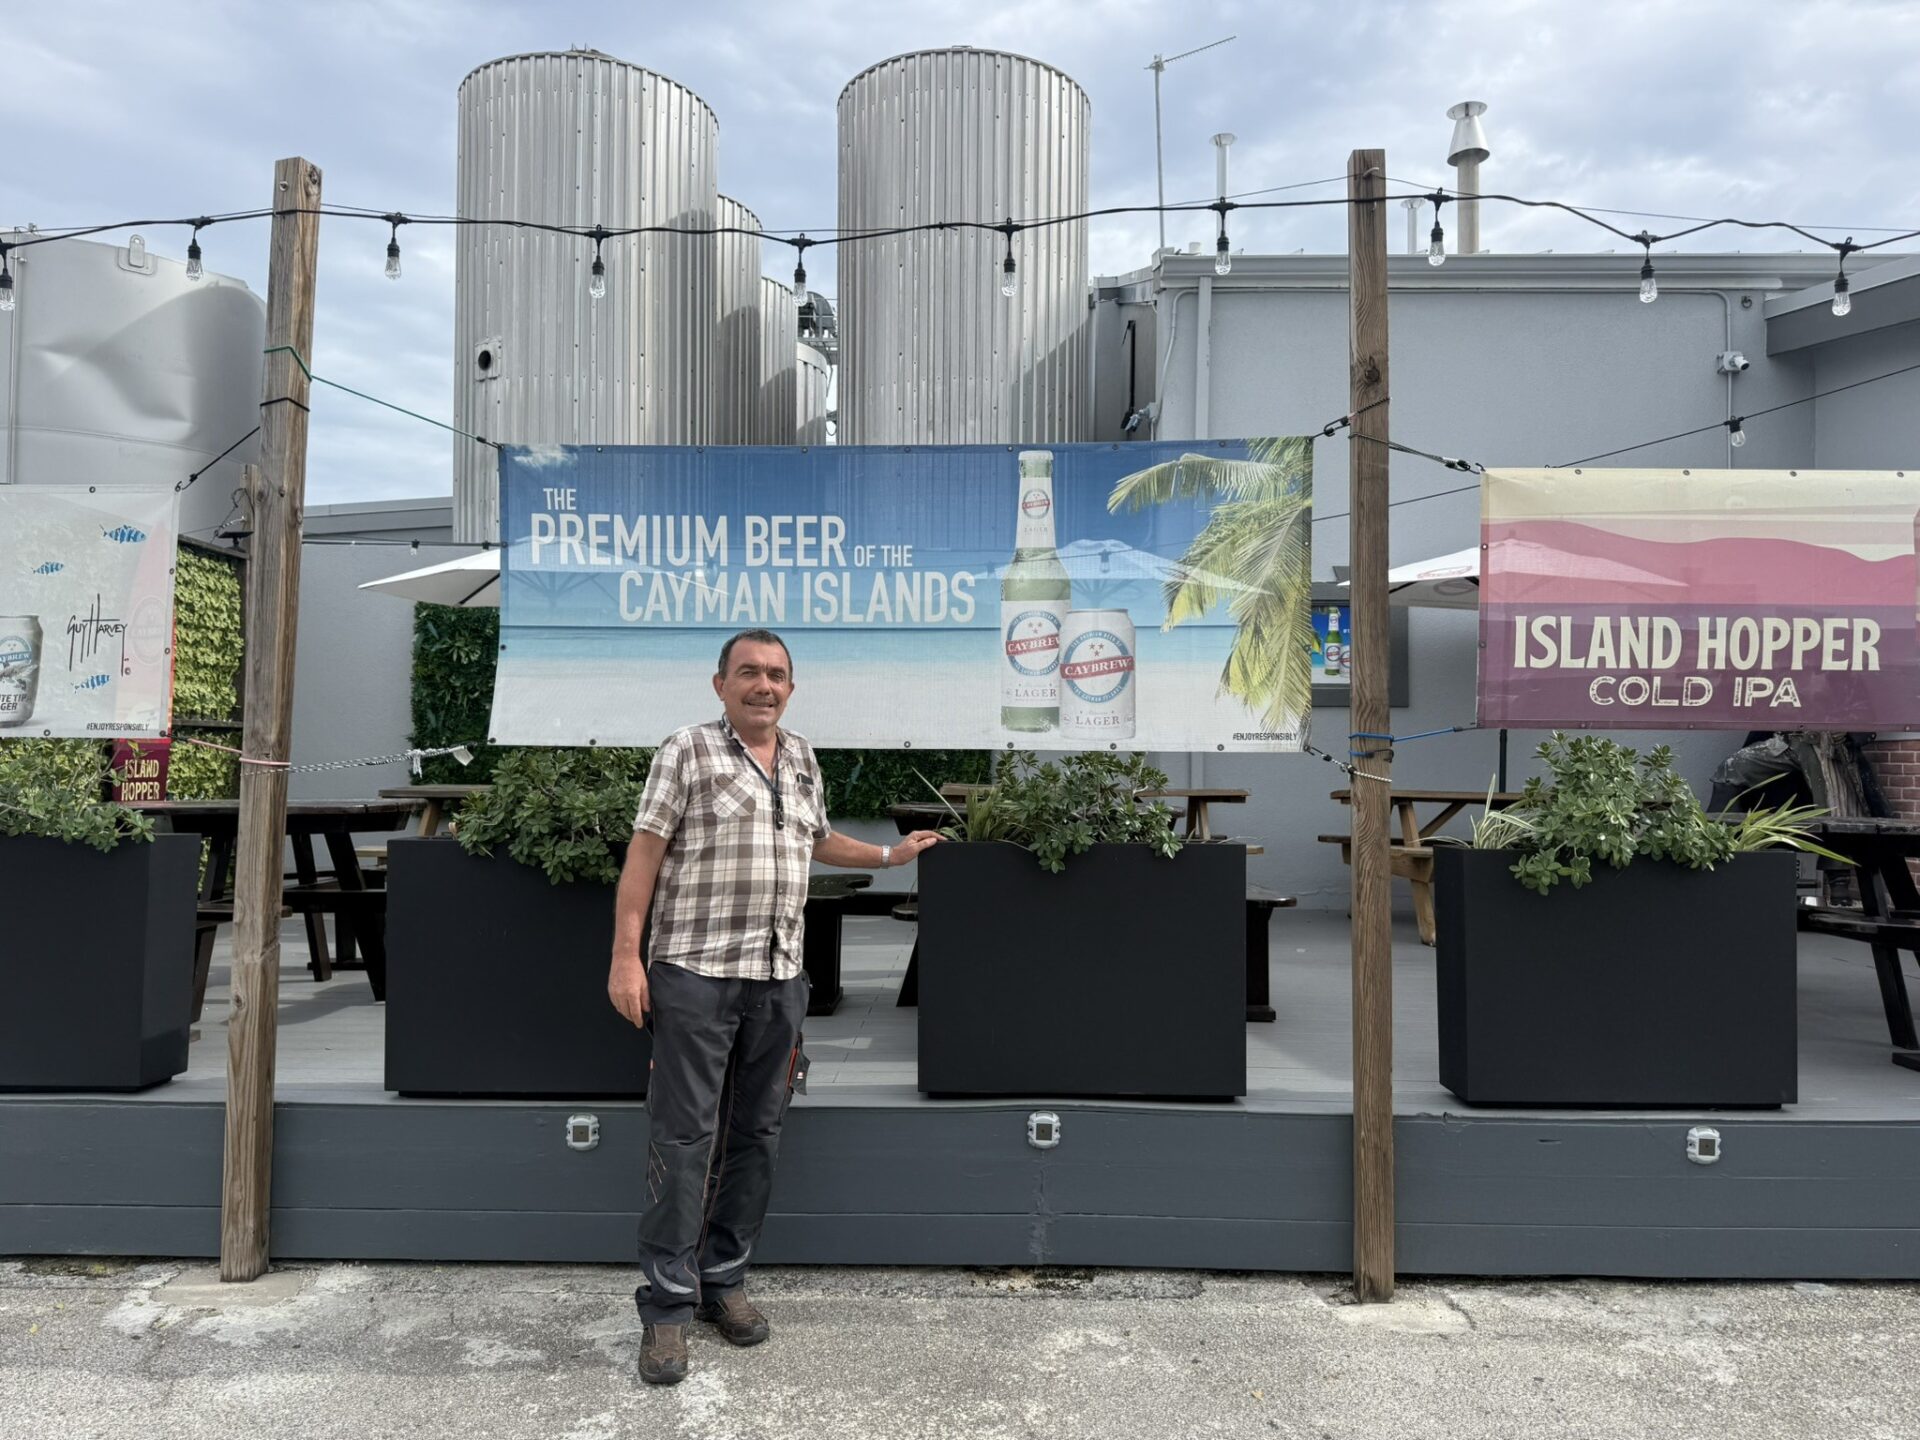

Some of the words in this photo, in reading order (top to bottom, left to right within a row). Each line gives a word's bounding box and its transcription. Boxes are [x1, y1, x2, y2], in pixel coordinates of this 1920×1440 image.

[543, 488, 577, 510] THE
[531, 513, 727, 566] PREMIUM
[745, 515, 846, 567] BEER
[854, 545, 875, 567] OF
[882, 545, 913, 567] THE
[619, 570, 784, 622] CAYMAN
[803, 571, 976, 623] ISLANDS
[1514, 615, 1682, 669] ISLAND
[1697, 616, 1881, 671] HOPPER
[1064, 658, 1130, 676] CAYBREW
[13, 694, 27, 703] TIP
[1015, 688, 1057, 698] LAGER
[1589, 675, 1713, 707] COLD
[1732, 677, 1802, 708] IPA
[86, 722, 150, 732] #ENJOYRESPONSIBLY
[1075, 715, 1121, 726] LAGER
[1232, 732, 1297, 741] #ENJOYRESPONSIBLY
[125, 759, 160, 779] ISLAND
[121, 781, 160, 801] HOPPER
